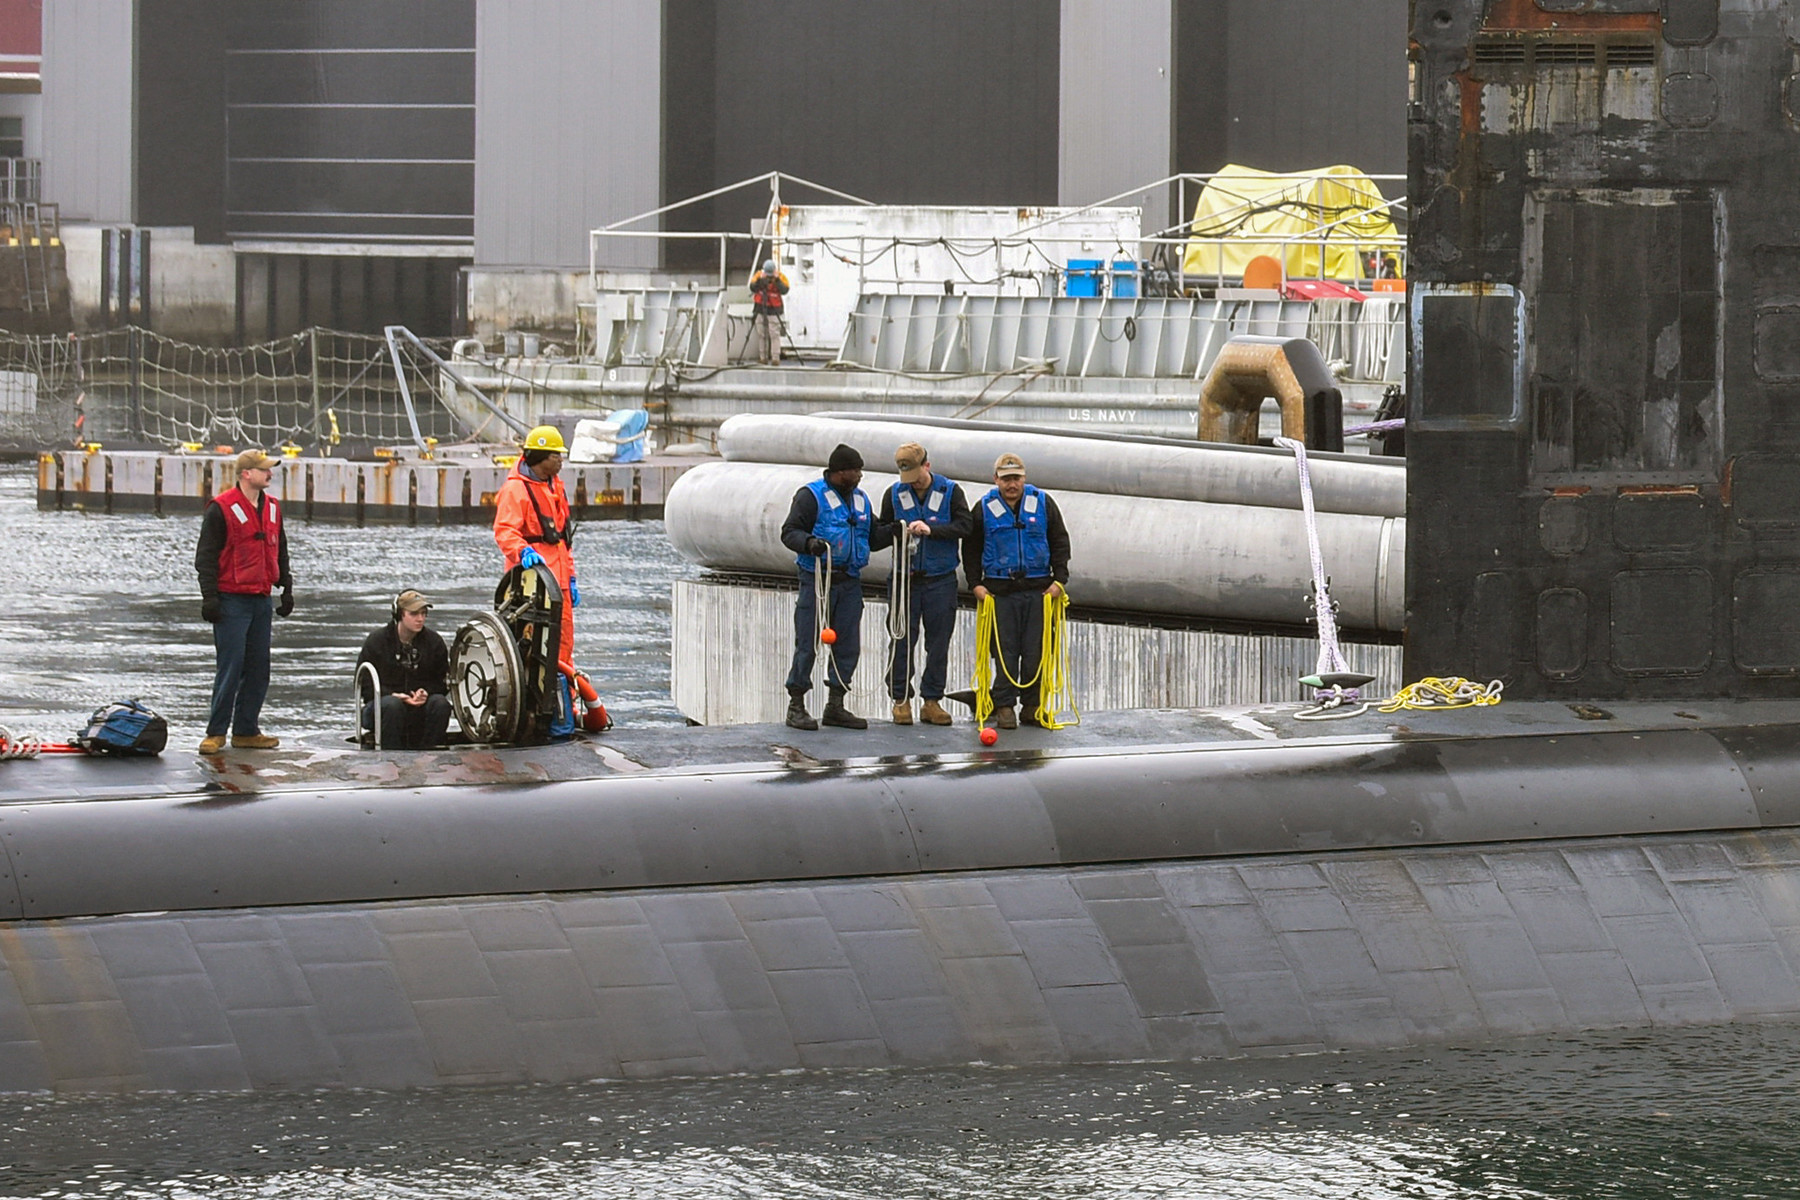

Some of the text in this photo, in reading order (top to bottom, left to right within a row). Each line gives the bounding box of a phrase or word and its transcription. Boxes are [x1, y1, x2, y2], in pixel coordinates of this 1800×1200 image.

[609, 369, 617, 381] 8
[1068, 408, 1095, 422] U.S.
[1098, 409, 1137, 423] NAVY
